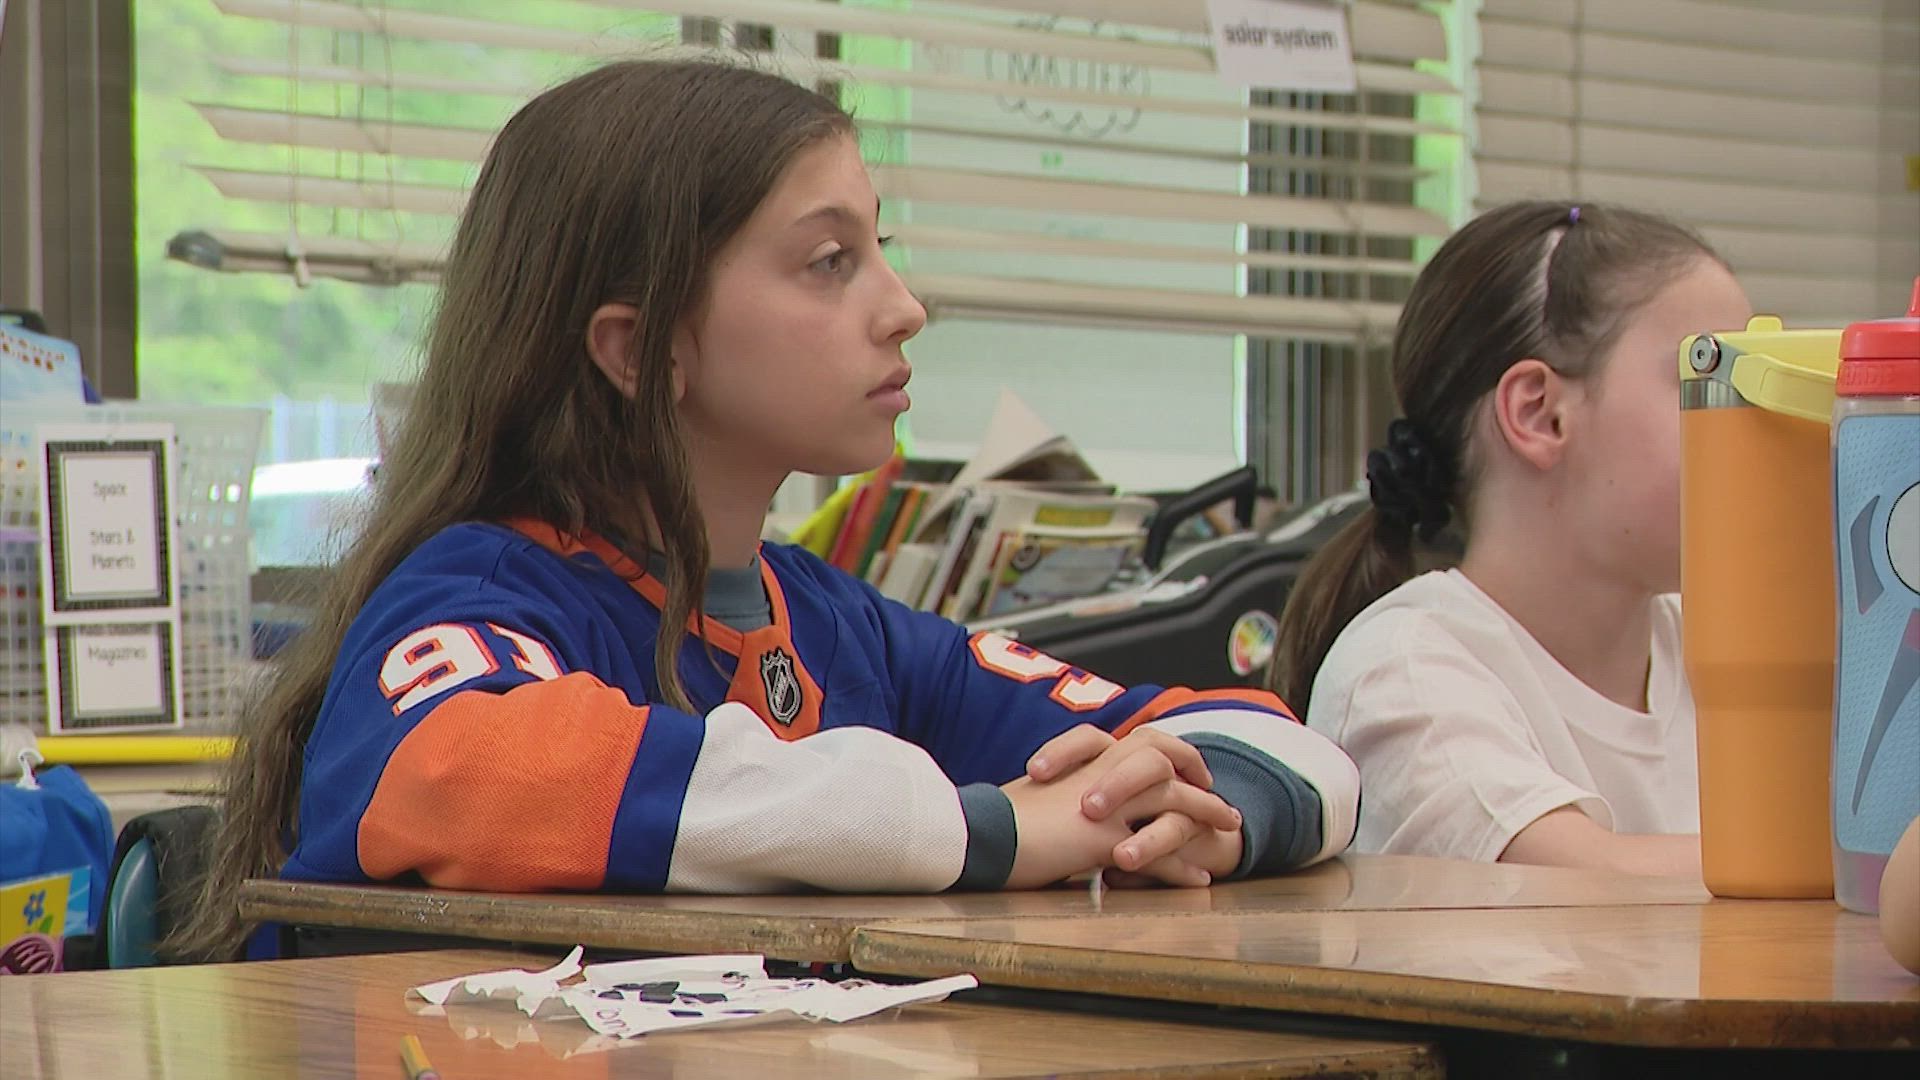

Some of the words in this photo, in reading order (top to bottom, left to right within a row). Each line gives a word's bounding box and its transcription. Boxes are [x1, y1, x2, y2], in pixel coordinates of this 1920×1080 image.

[1224, 19, 1266, 45] solar
[1270, 25, 1339, 54] system
[90, 529, 122, 545] Stars
[92, 554, 136, 571] Planets
[378, 621, 565, 717] 91
